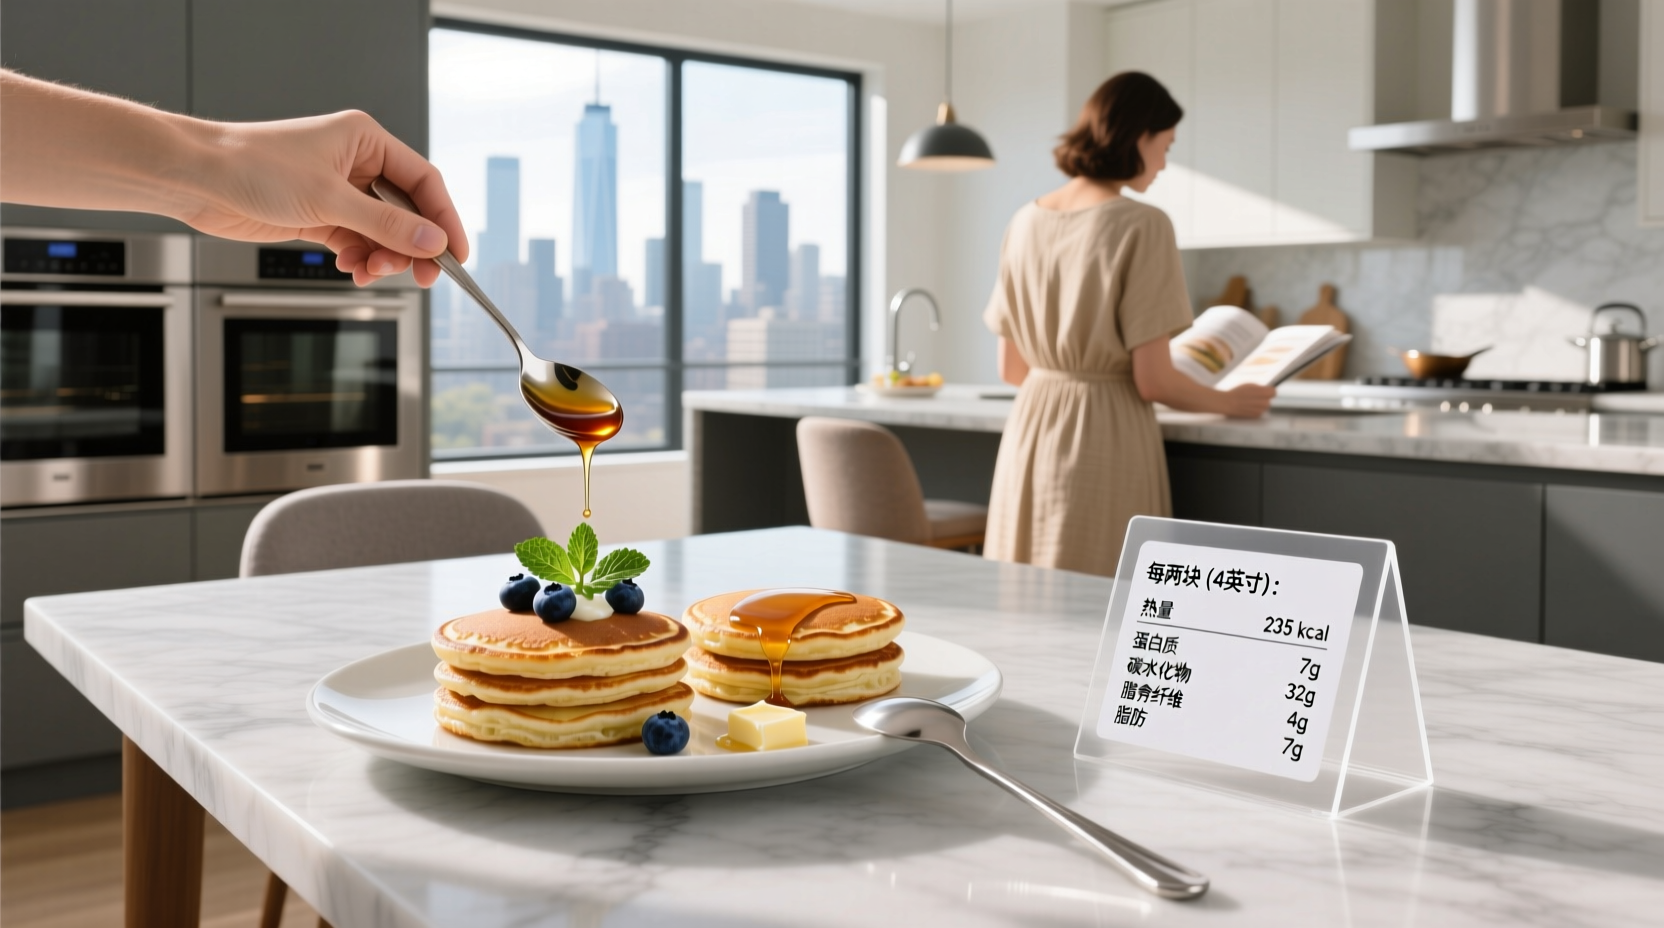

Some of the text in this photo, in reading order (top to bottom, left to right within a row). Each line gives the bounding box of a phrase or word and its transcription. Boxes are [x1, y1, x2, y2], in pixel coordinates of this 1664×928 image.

[1146, 561, 1201, 588] 每两块
[1140, 598, 1330, 642] 热量 235 kcal
[1132, 631, 1321, 681] 蛋白质 7g
[1284, 683, 1316, 708] 32g
[1286, 711, 1309, 735] 4g
[1281, 737, 1304, 762] 7g
